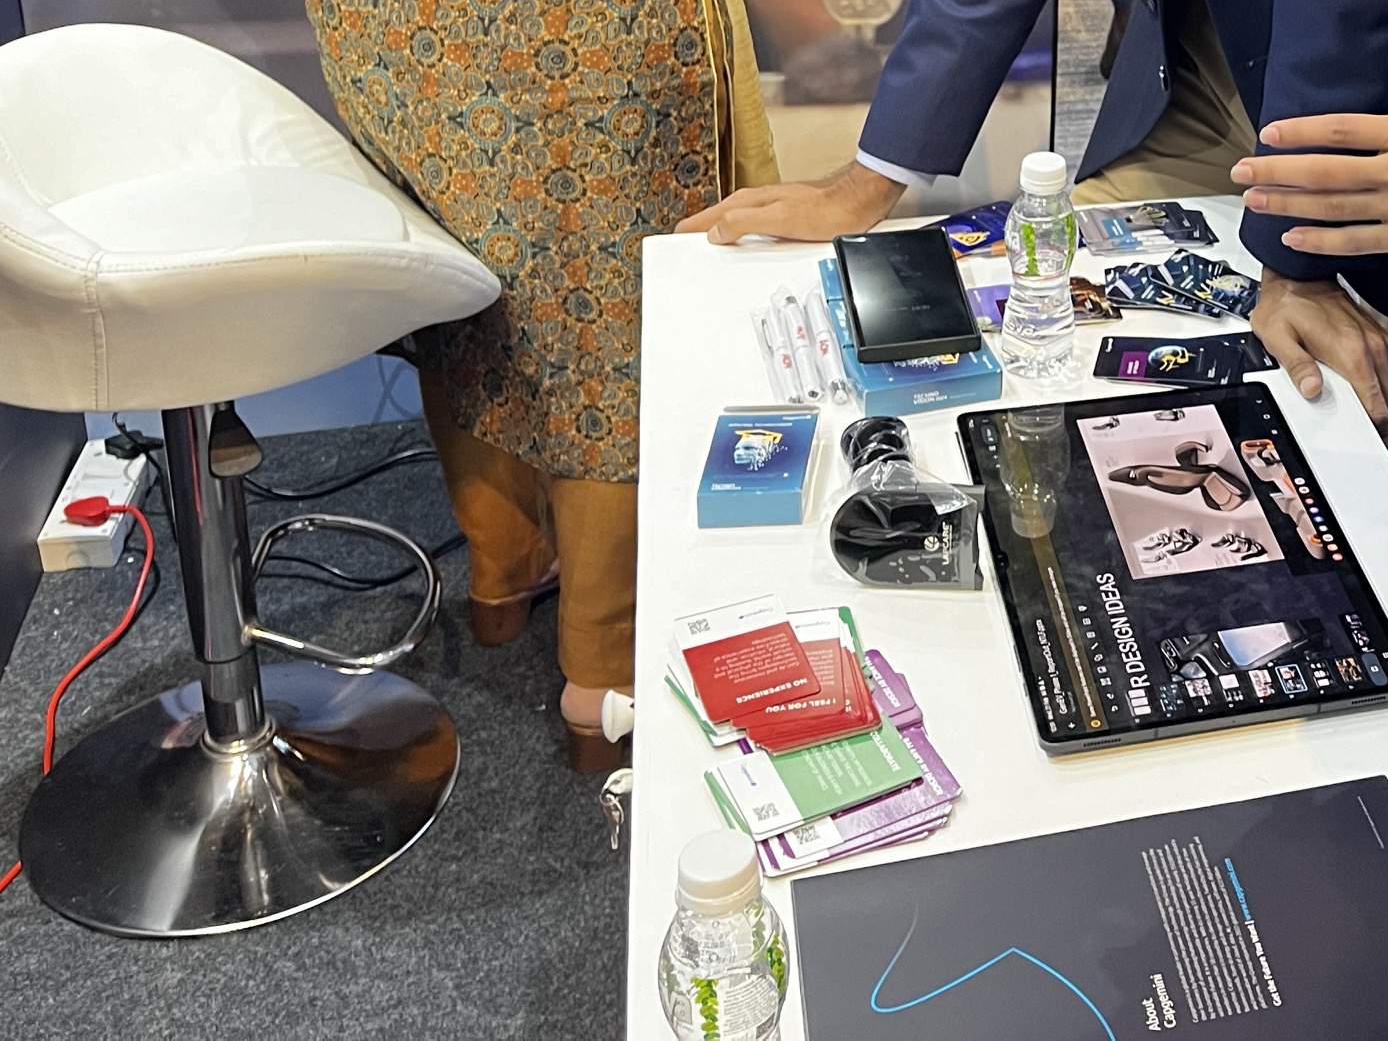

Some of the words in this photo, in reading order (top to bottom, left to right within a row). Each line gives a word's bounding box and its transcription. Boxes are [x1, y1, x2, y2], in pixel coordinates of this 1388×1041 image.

[1096, 572, 1126, 615] IDEAS
[1109, 617, 1147, 674] DESIGN
[736, 683, 793, 705] EXPERIENCE
[792, 678, 807, 690] NO
[786, 700, 807, 710] FOR
[869, 731, 901, 772] COLLABORATE
[1247, 925, 1259, 943] Want
[1254, 942, 1264, 956] You
[1259, 956, 1273, 980] Future
[1267, 979, 1277, 993] the
[1150, 973, 1177, 1029] Capgemini
[1271, 991, 1283, 1007] Get
[1140, 997, 1162, 1032] About
